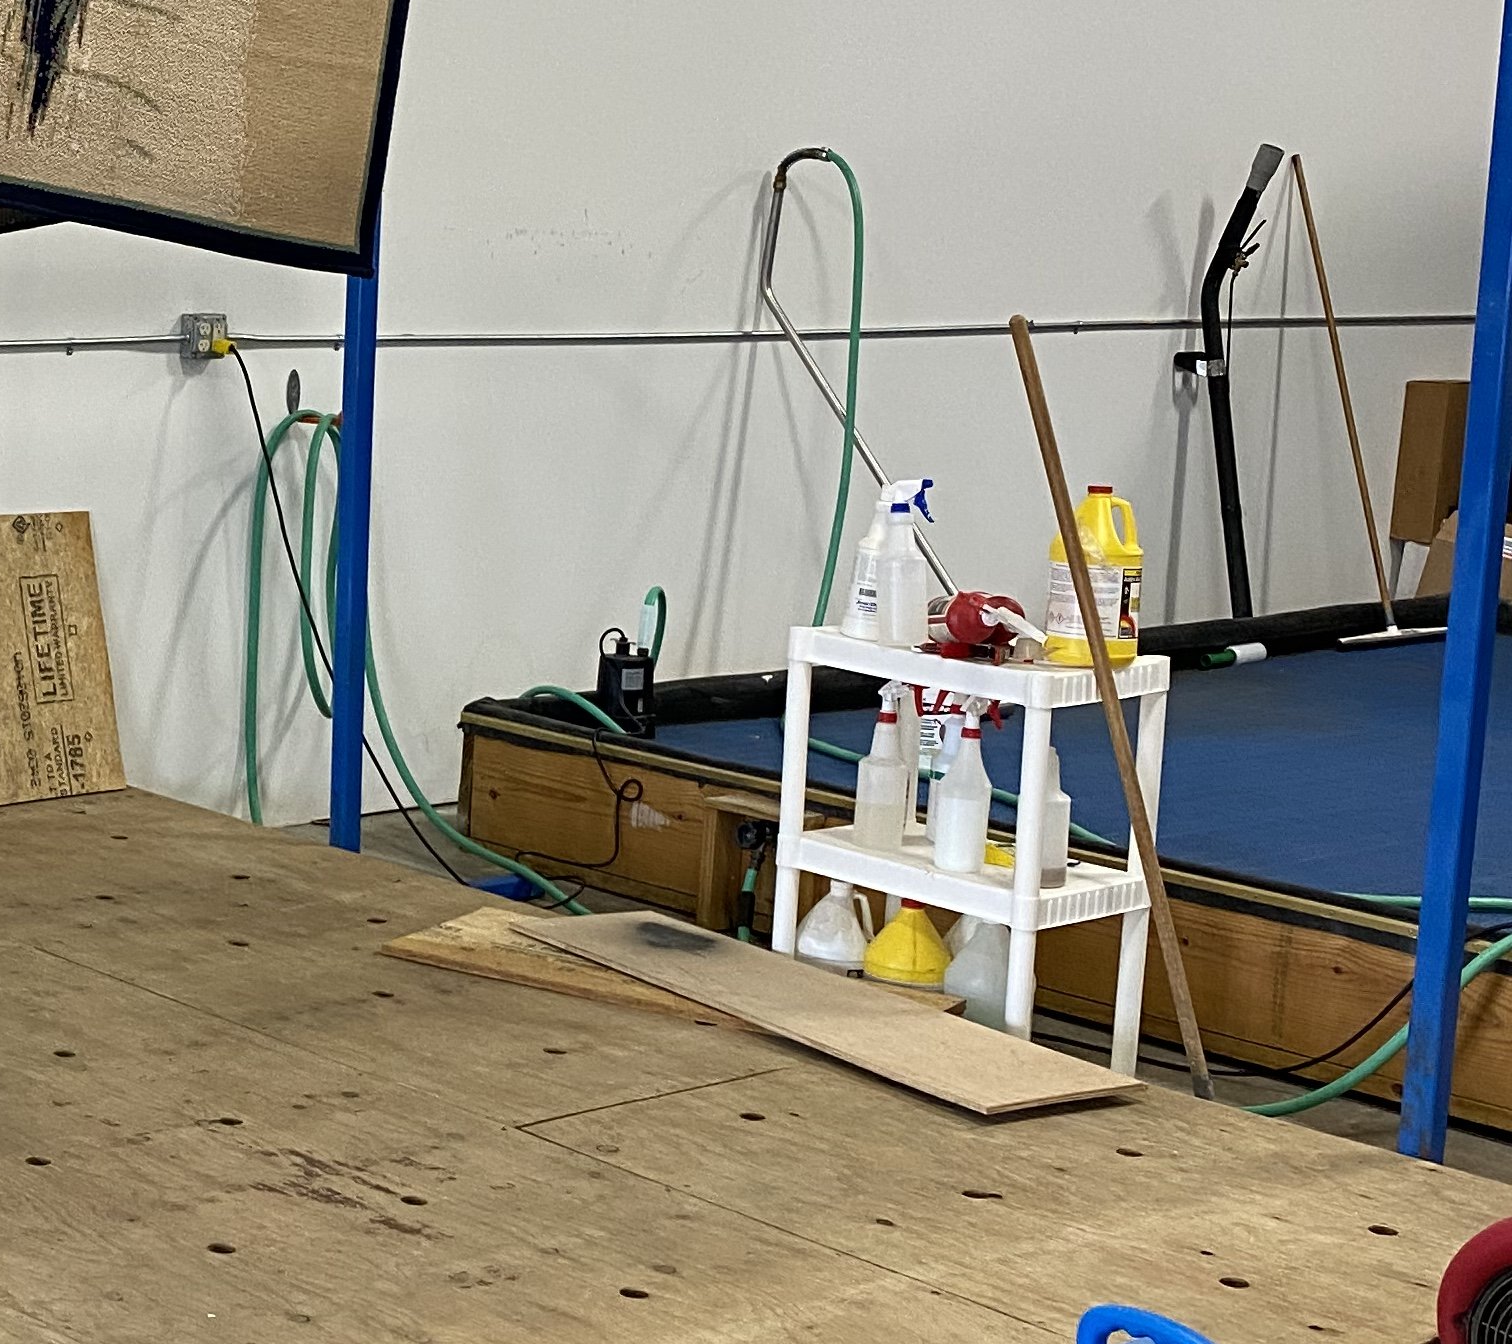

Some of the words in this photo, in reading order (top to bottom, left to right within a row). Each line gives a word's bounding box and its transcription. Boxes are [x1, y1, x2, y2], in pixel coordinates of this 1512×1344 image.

[27, 582, 58, 697] LIFETIME
[44, 580, 62, 650] WARRANTY
[55, 651, 69, 698] LIMITED
